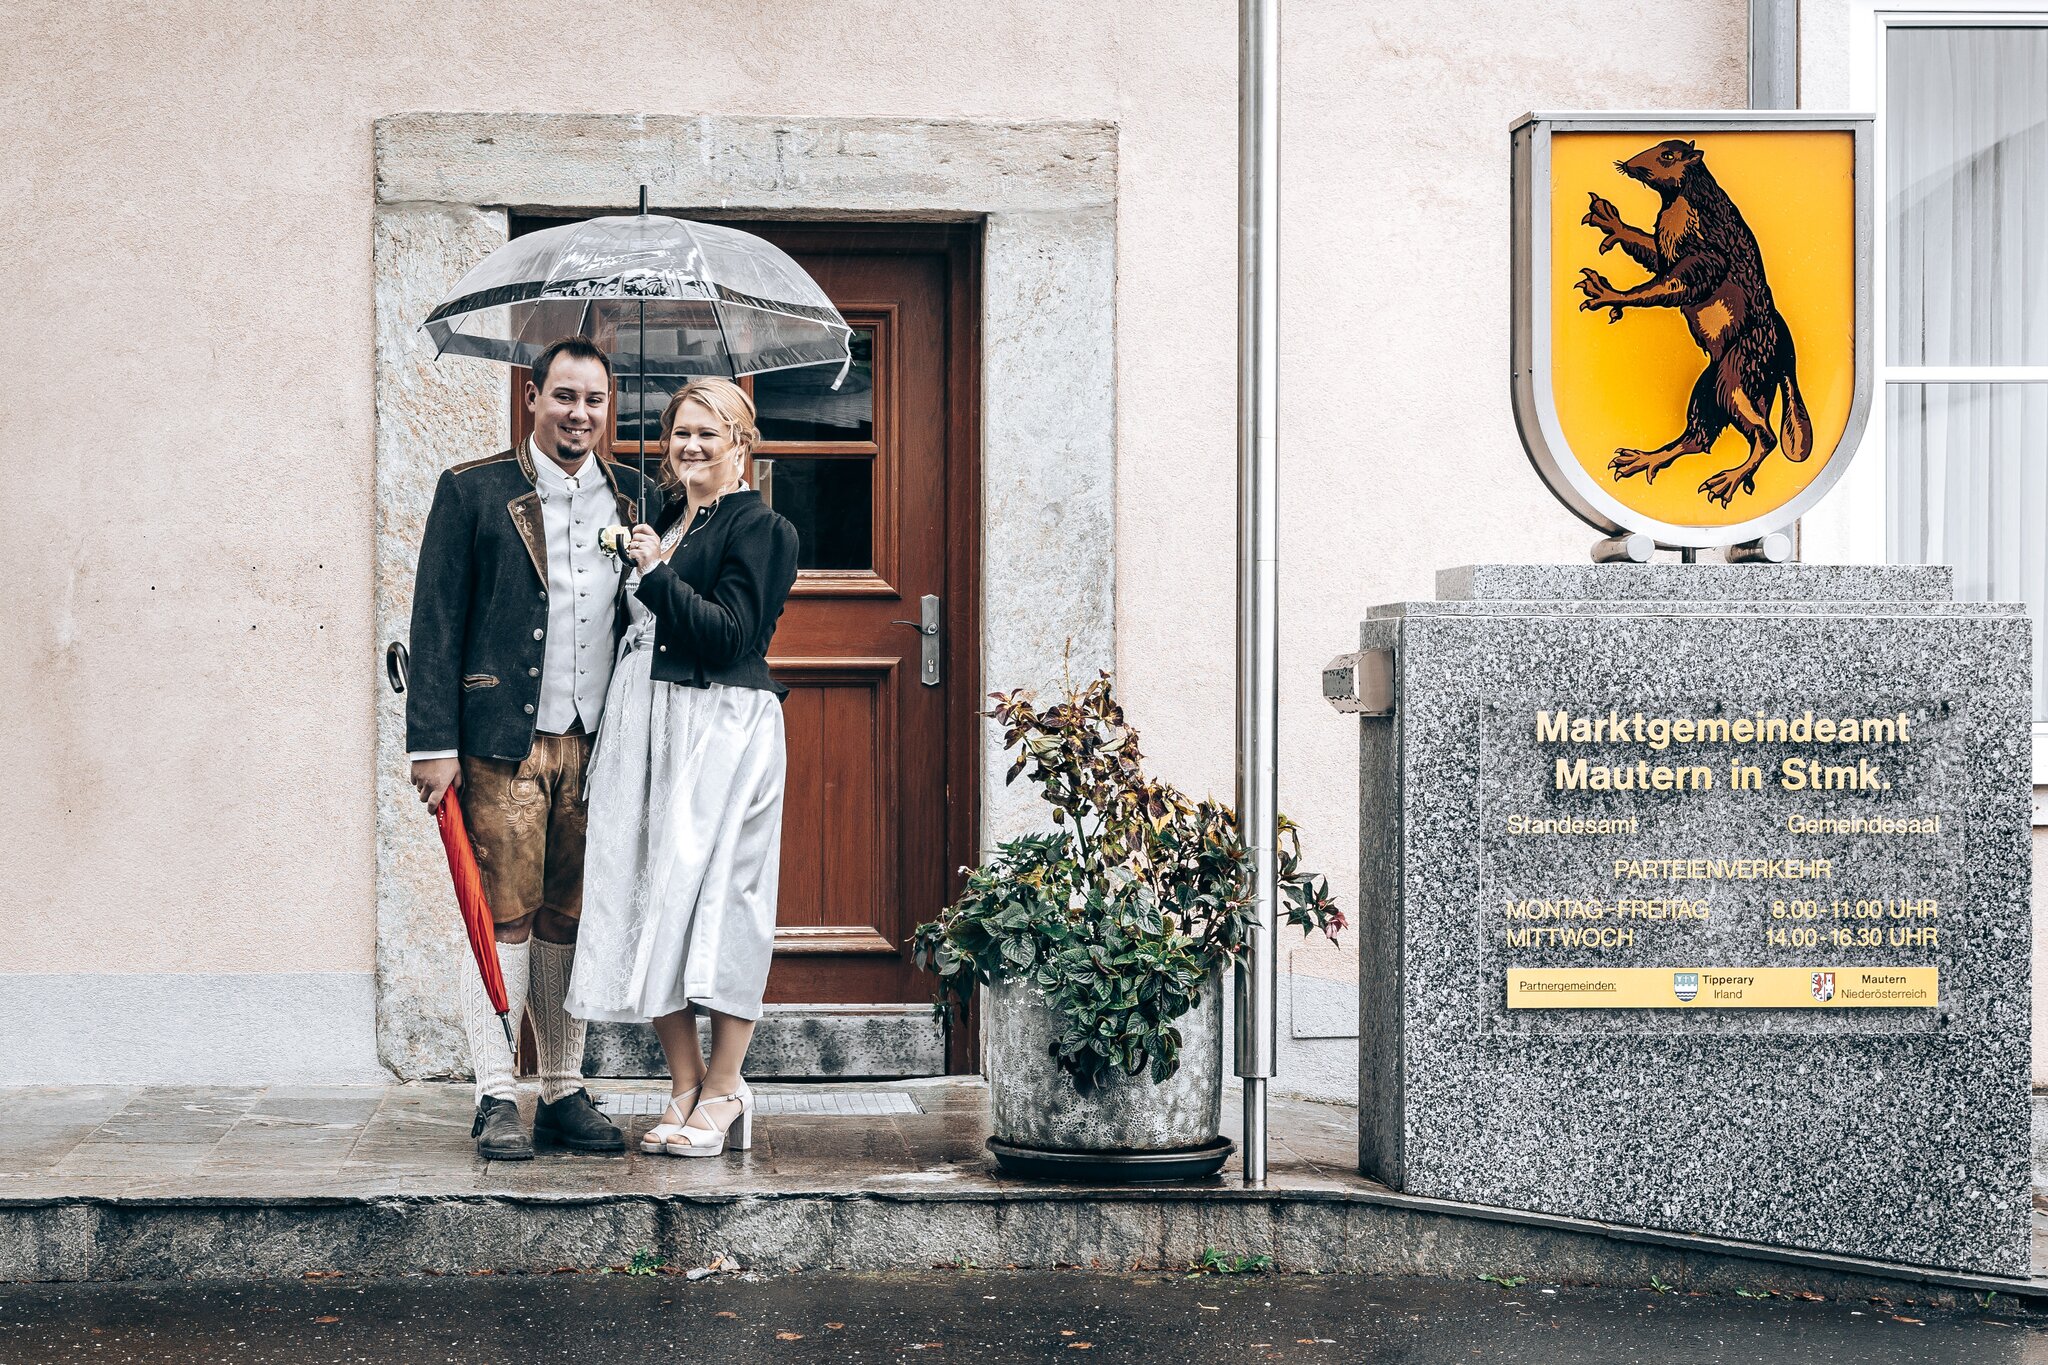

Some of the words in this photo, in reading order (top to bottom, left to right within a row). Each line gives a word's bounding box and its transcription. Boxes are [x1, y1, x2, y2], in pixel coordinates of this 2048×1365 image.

[1536, 710, 1911, 750] Marktgemeindeamt
[1556, 758, 1712, 791] Mautern
[1731, 758, 1762, 790] in
[1781, 757, 1891, 791] Stmk.
[1507, 814, 1639, 835] Standesamt
[1787, 814, 1940, 834] Gemeindesaal
[1614, 859, 1832, 879] PARTEIENVERKEHR
[1506, 899, 1710, 920] MONTAG-FREITAG
[1889, 899, 1938, 919] UHR
[1506, 927, 1634, 948] MITTWOCH
[1889, 927, 1938, 947] UHR
[1519, 980, 1617, 992] Partnergemeinden:
[1702, 974, 1754, 986] Tipperary
[1861, 974, 1907, 984] Mautern
[1714, 989, 1743, 999] Irland
[1841, 988, 1927, 999] Niederösterreich
